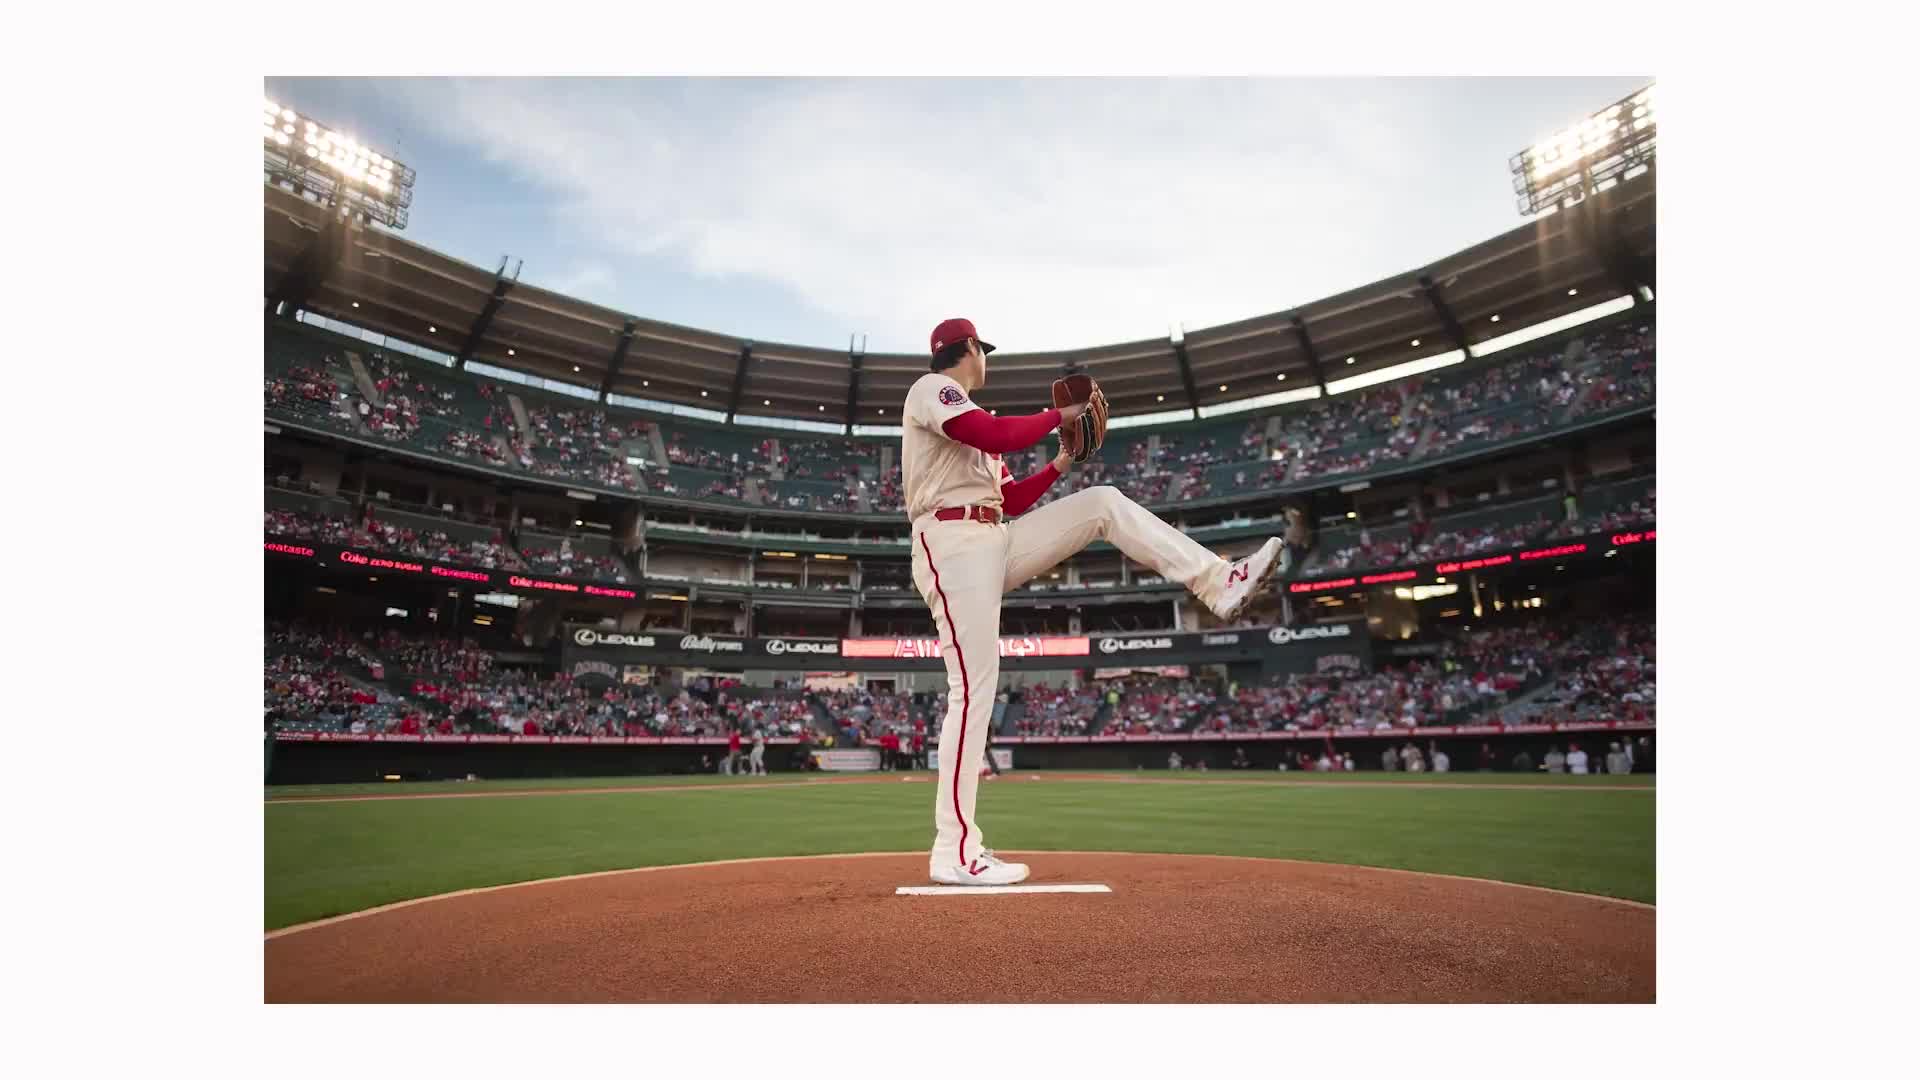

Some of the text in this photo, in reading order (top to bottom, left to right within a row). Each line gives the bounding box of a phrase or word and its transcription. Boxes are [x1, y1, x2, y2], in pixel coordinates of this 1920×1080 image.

[340, 551, 369, 565] Coke
[1290, 625, 1351, 640] LEXUS
[598, 634, 656, 647] LEXUS
[1118, 637, 1173, 649] LEXUS
[785, 642, 839, 654] LEXUS
